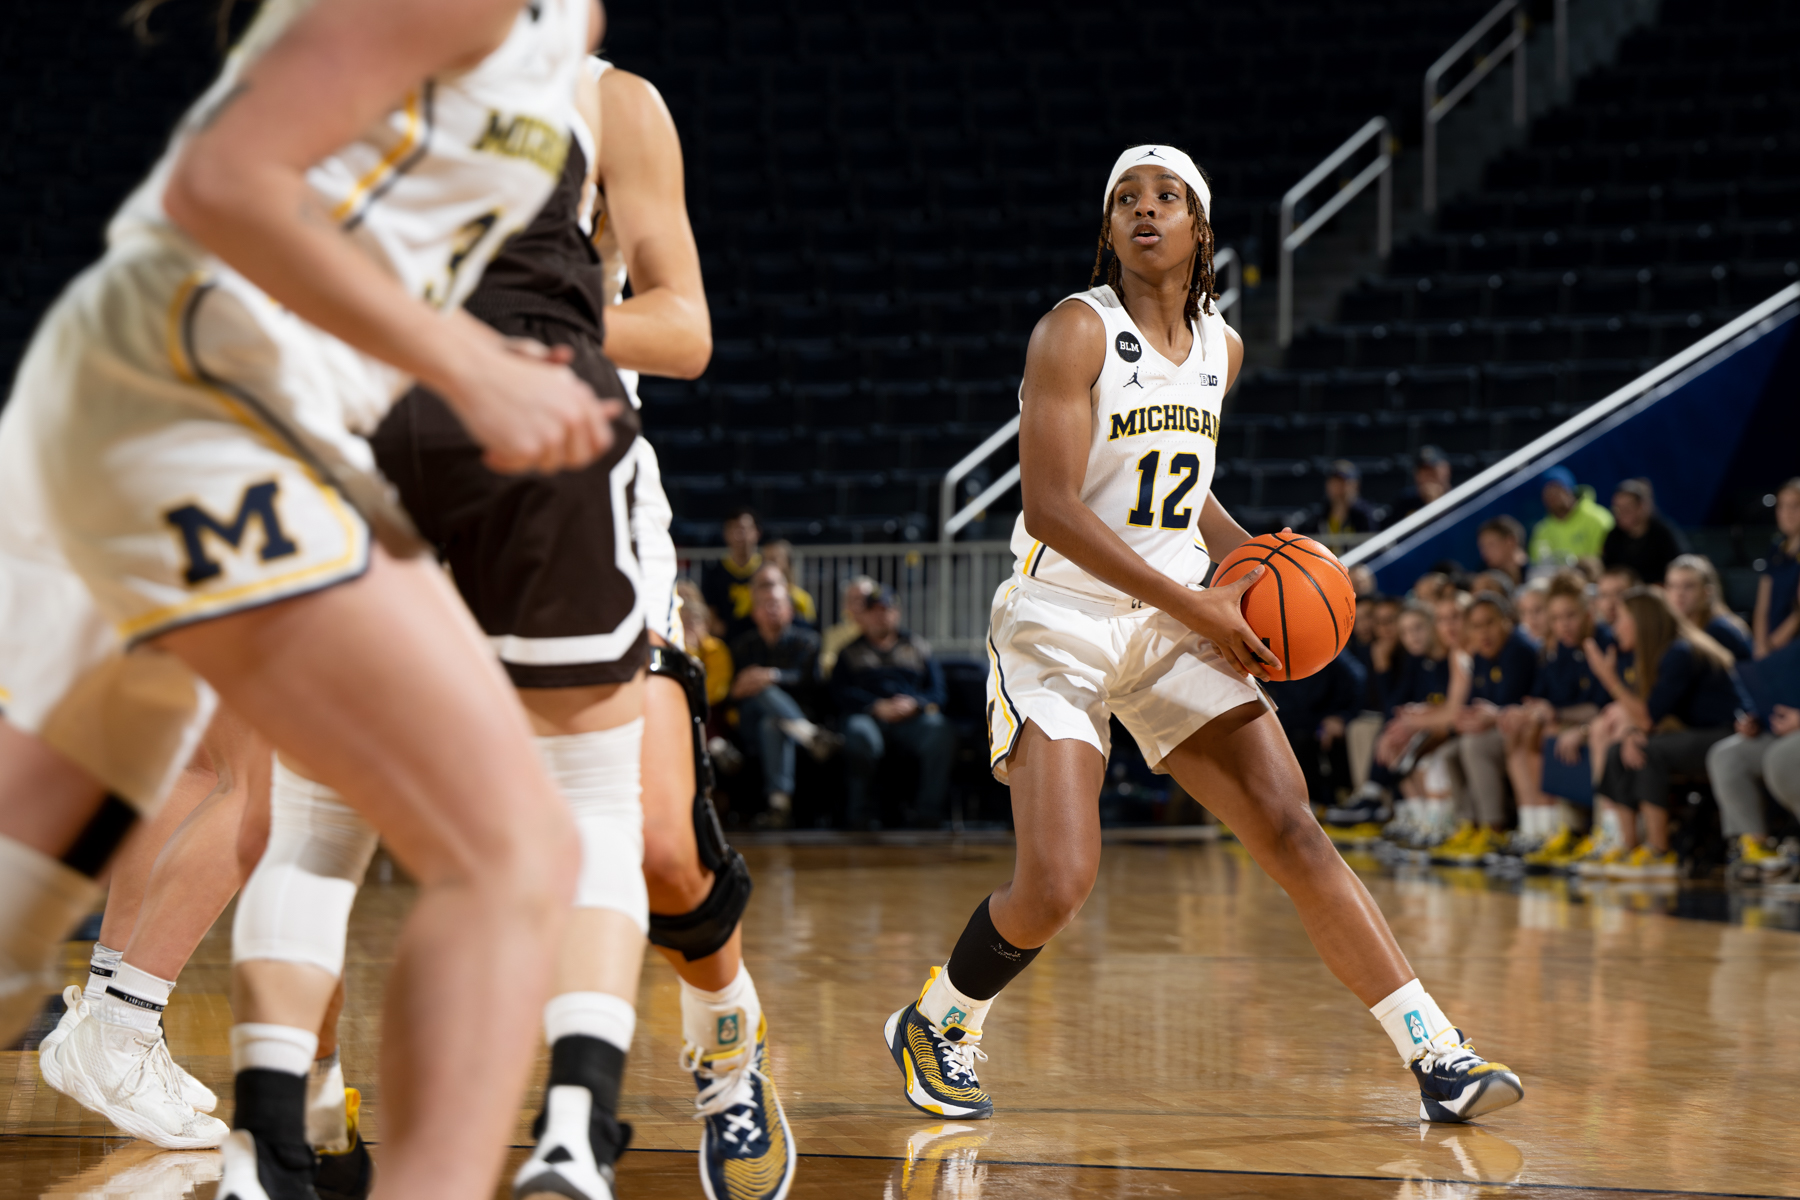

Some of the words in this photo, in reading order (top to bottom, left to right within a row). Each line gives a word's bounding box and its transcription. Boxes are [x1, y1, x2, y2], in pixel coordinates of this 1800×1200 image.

[1119, 340, 1140, 353] BLM
[1126, 449, 1200, 531] 12
[165, 478, 299, 585] M
